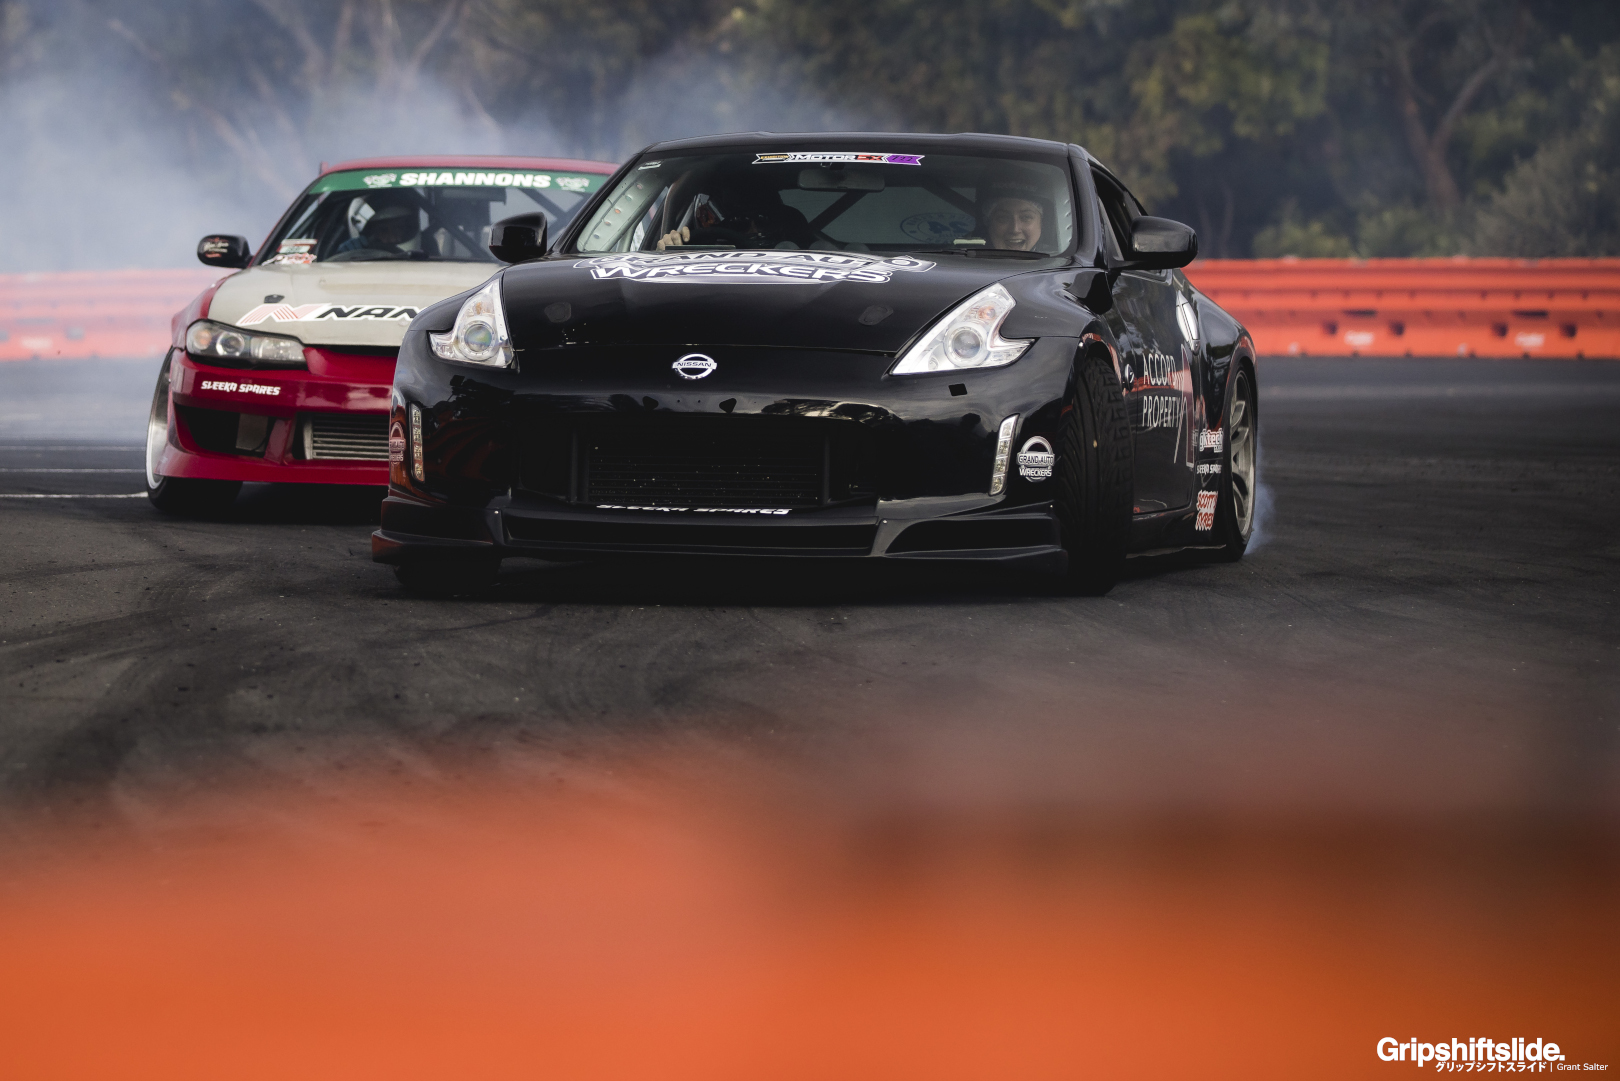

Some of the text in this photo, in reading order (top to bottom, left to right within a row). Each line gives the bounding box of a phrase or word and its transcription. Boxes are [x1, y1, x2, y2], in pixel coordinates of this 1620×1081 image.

[399, 172, 552, 188] SHANNONS
[589, 252, 922, 268] GRAND AUTO
[595, 262, 890, 283] WRECKERS
[1142, 353, 1177, 386] ACCORD
[201, 380, 281, 396] SLEEKA SPARES
[1142, 395, 1181, 428] PROPERTY
[1019, 455, 1054, 464] GRAND AUTO
[1019, 468, 1052, 476] WRECKERS
